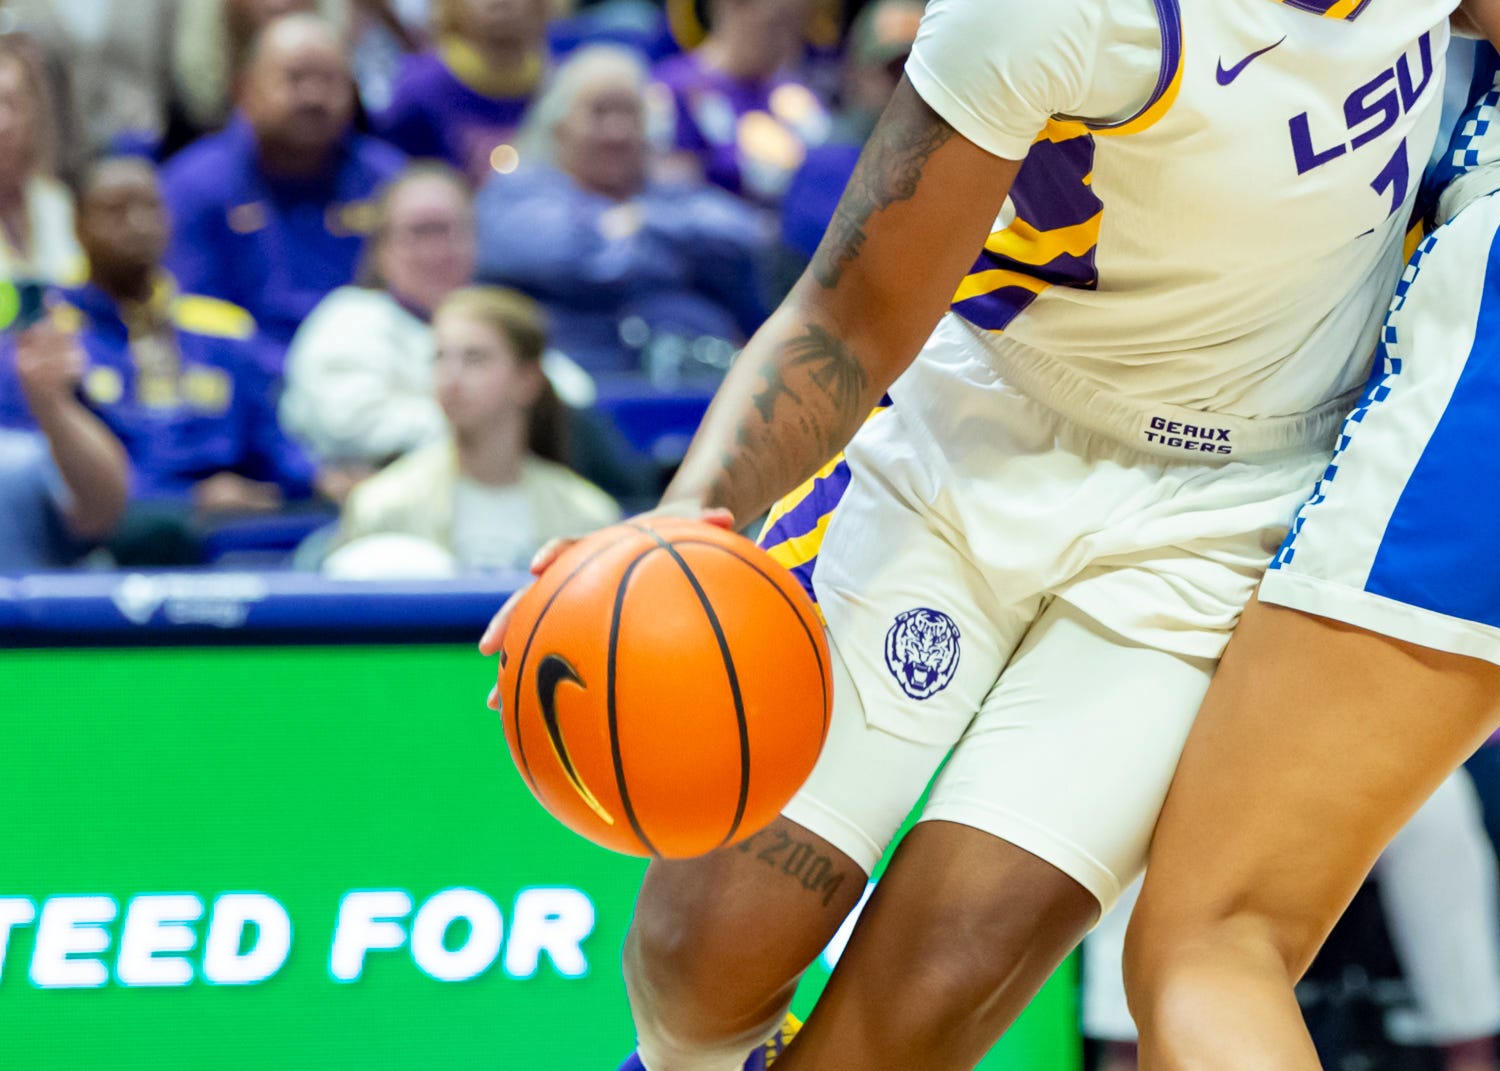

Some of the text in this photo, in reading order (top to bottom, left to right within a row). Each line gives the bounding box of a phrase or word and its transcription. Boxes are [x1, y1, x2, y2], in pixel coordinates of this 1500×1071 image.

[1288, 31, 1433, 176] LSU
[1144, 430, 1232, 455] TIGERS
[1150, 416, 1231, 442] GEAUX
[328, 885, 596, 983] FOR
